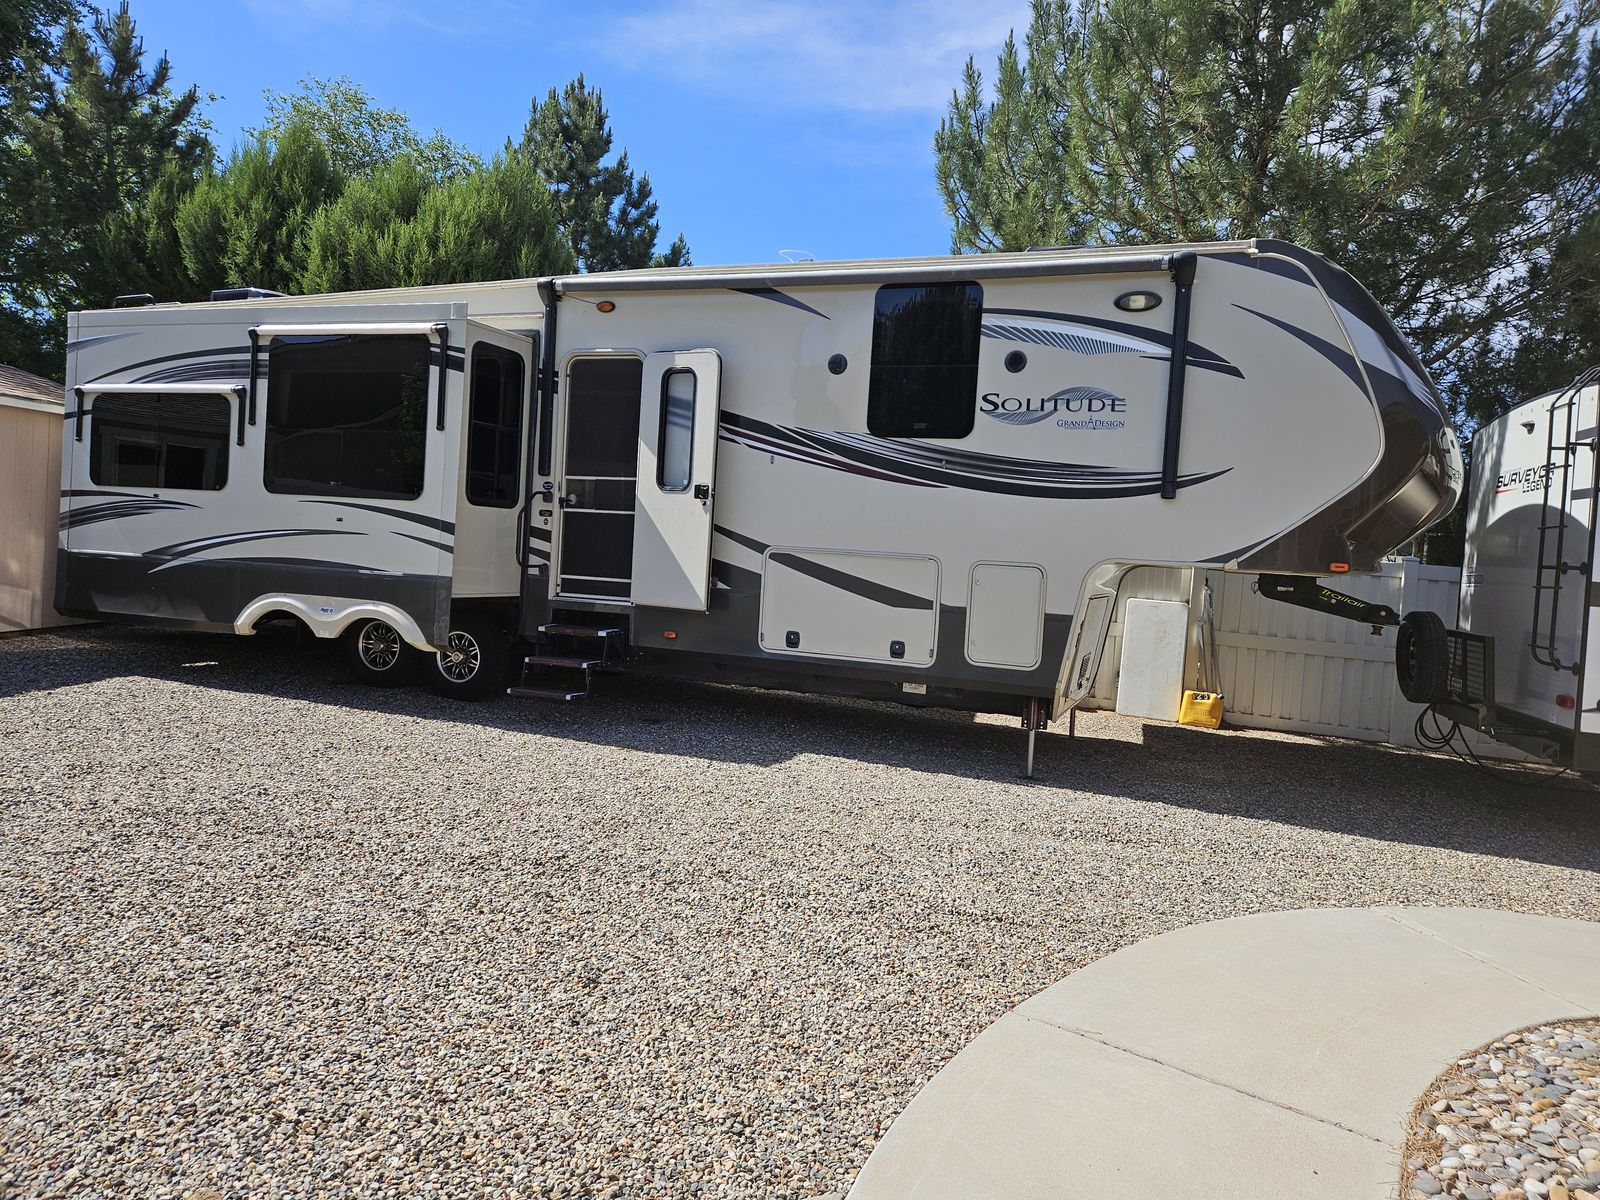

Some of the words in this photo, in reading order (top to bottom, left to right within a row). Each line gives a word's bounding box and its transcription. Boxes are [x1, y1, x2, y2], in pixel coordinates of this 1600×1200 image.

[979, 392, 1127, 413] SOLITUDE
[1056, 418, 1087, 428] GRAND
[1094, 419, 1126, 428] DESIGN
